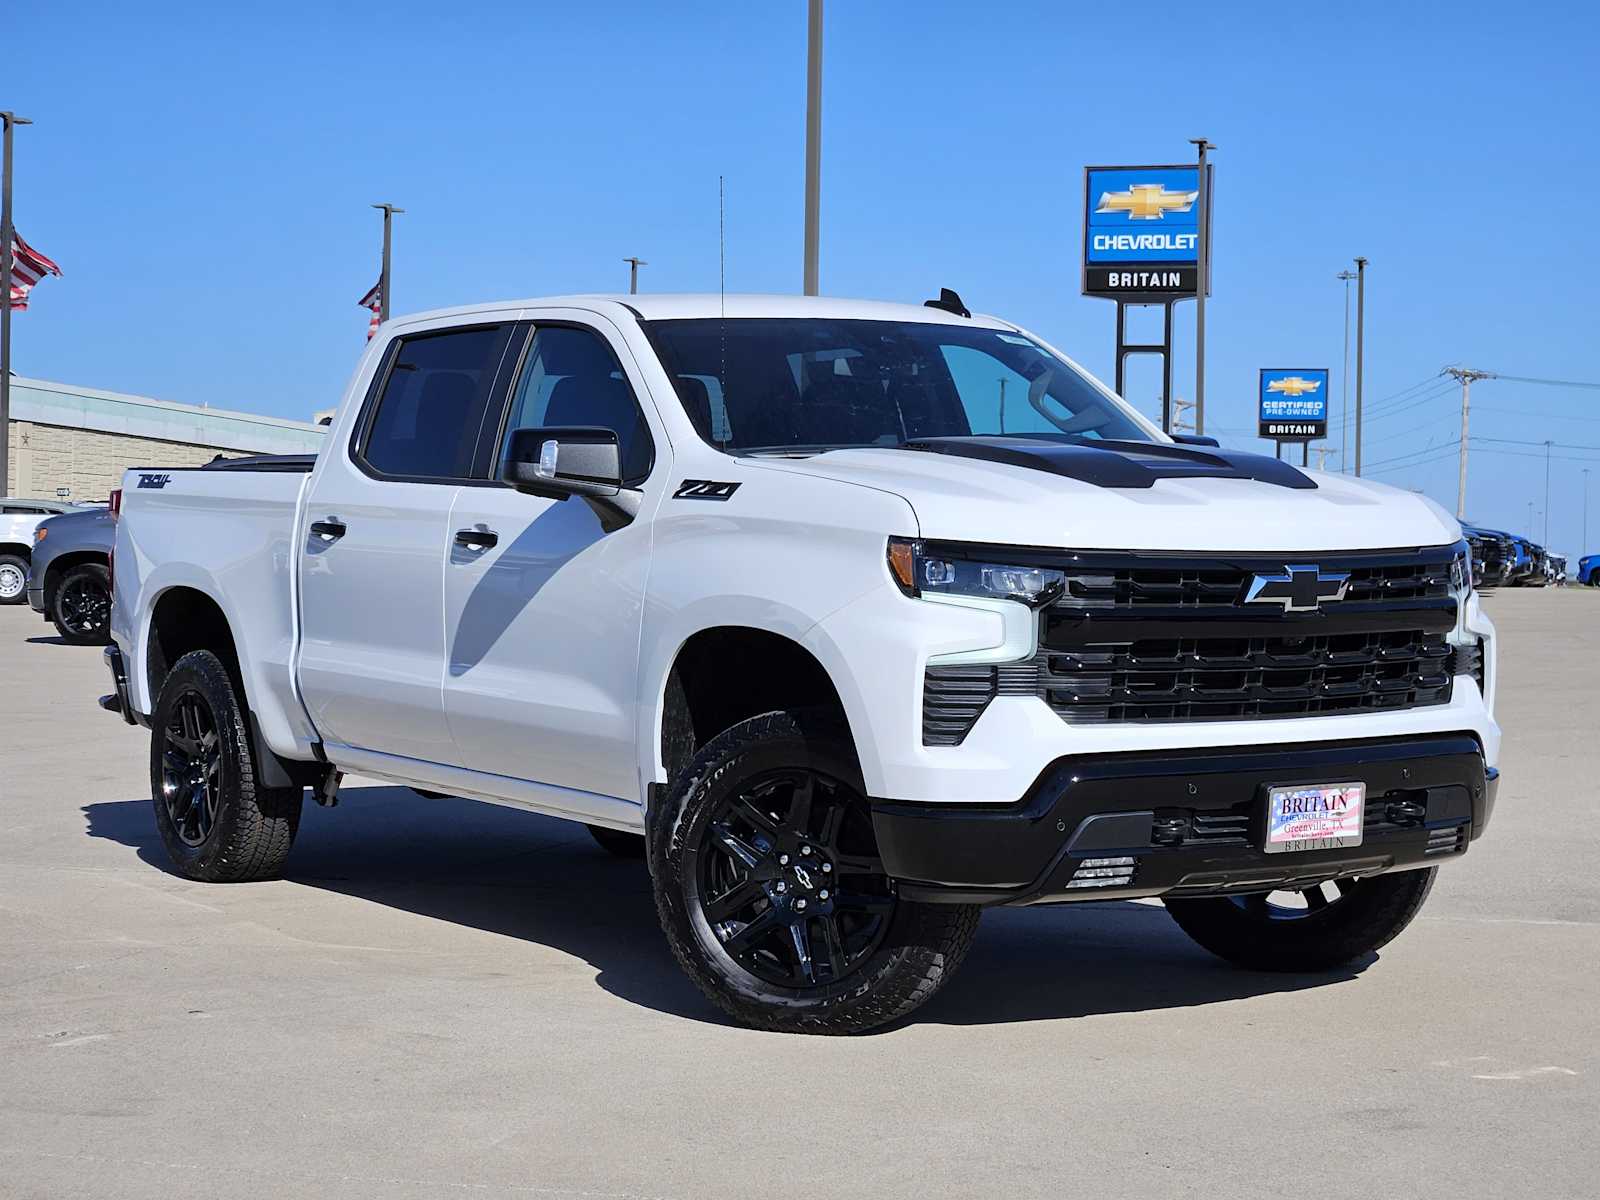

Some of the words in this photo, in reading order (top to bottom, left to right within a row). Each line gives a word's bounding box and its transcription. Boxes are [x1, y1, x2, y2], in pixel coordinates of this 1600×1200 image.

[1093, 234, 1198, 250] CHEVROLET
[1108, 272, 1181, 287] BRITAIN
[1263, 401, 1323, 409] CERTIFIED
[1269, 425, 1316, 434] BRITAIN
[1282, 794, 1349, 814] BRITAIN
[1281, 811, 1329, 822] CHEVROLET
[1284, 820, 1329, 834] Greenville,
[1285, 836, 1344, 851] BRITAIN
